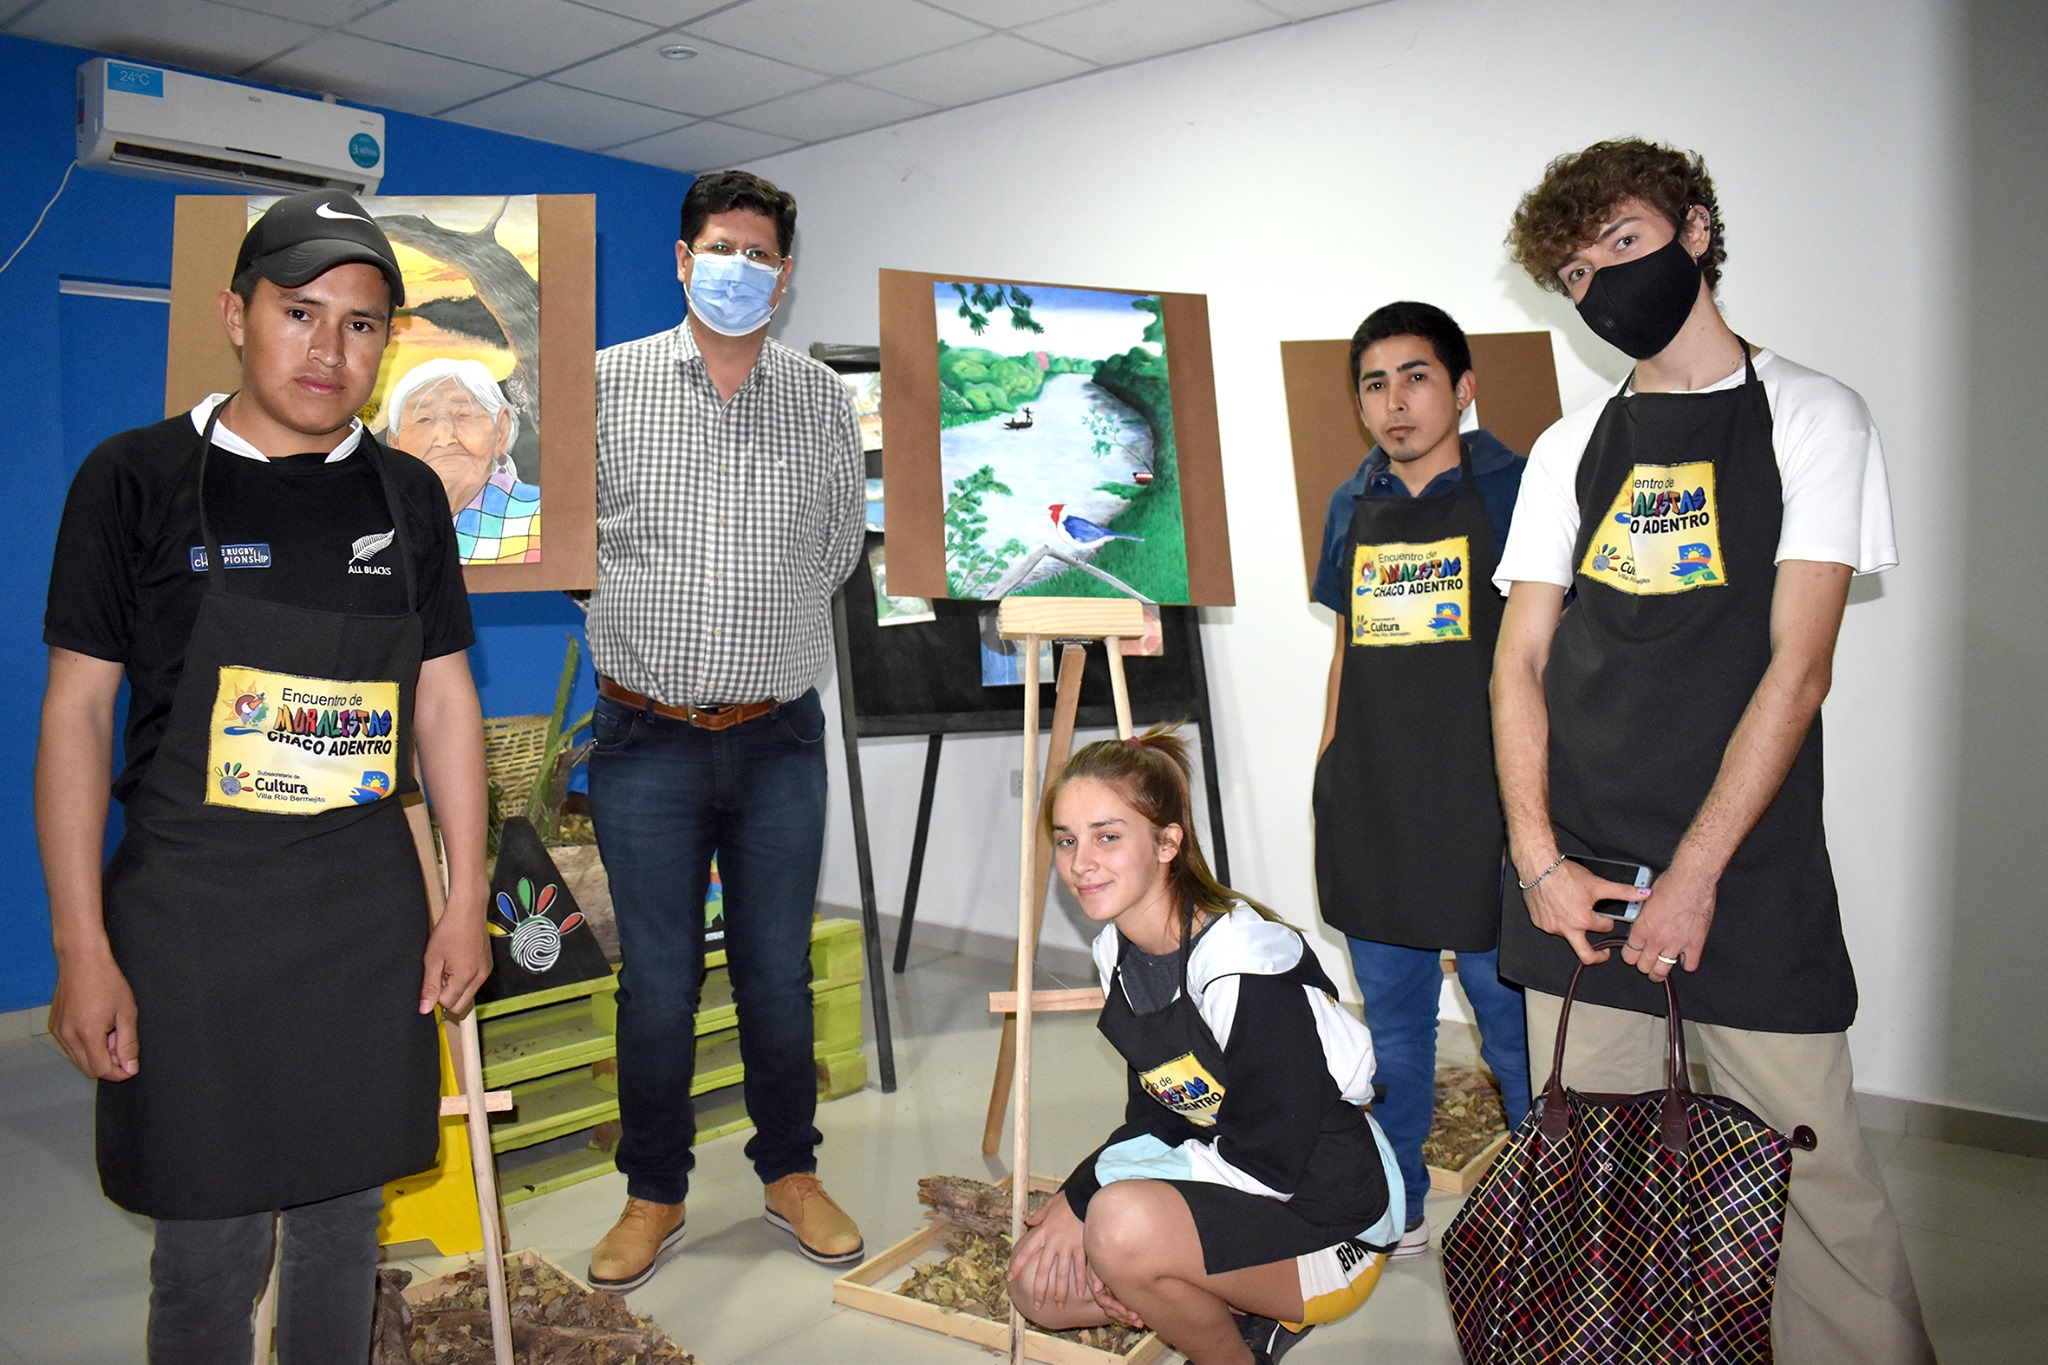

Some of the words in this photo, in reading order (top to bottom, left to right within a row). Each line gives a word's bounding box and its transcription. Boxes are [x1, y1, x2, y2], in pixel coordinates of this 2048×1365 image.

[1633, 476, 1663, 489] entro
[1631, 486, 1707, 518] ALISTAS
[1643, 511, 1710, 535] ADENTRO
[227, 547, 254, 556] RUGBY
[1378, 552, 1424, 564] Encuentro
[1426, 550, 1437, 559] de
[348, 565, 363, 575] ALL
[364, 566, 392, 576] BLACKS
[1373, 585, 1405, 598] CHACO
[1408, 578, 1464, 595] ADENTRO
[1370, 621, 1400, 633] Cultura
[281, 687, 347, 706] Encuentro
[349, 693, 363, 706] de
[273, 704, 393, 739] MURALISTAS
[267, 730, 325, 756] CHACO
[328, 739, 392, 756] ADENTRO
[254, 777, 309, 795] Cultura
[256, 792, 273, 801] Villa
[290, 795, 326, 804] Bermejito
[1160, 1076, 1173, 1088] de
